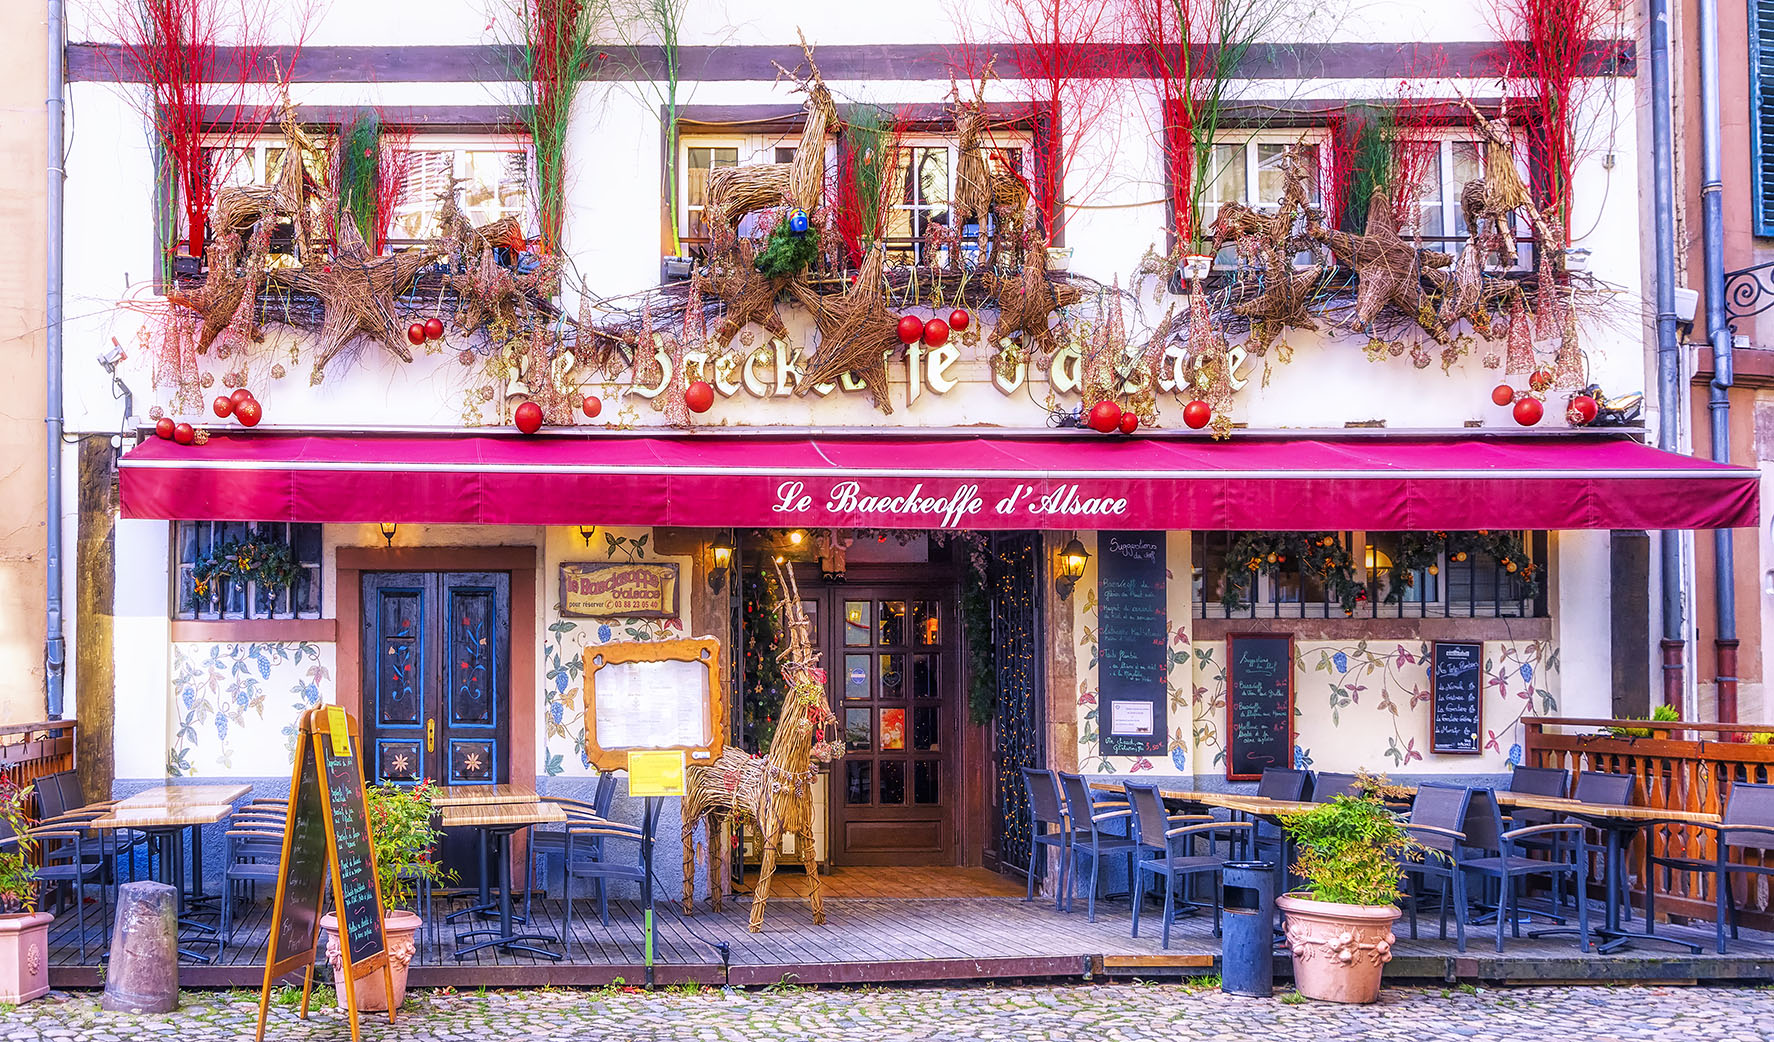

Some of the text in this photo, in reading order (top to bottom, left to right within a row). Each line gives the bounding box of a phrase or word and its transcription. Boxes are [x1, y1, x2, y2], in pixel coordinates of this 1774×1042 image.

[771, 481, 811, 513] Le
[826, 481, 983, 528] Baeckeoffe
[1109, 537, 1158, 557] Suggestions
[582, 600, 604, 608] réserver
[614, 600, 622, 609] 03
[624, 600, 631, 609] 88
[632, 600, 640, 609] 23
[642, 600, 649, 609] 05
[650, 600, 658, 609] 40
